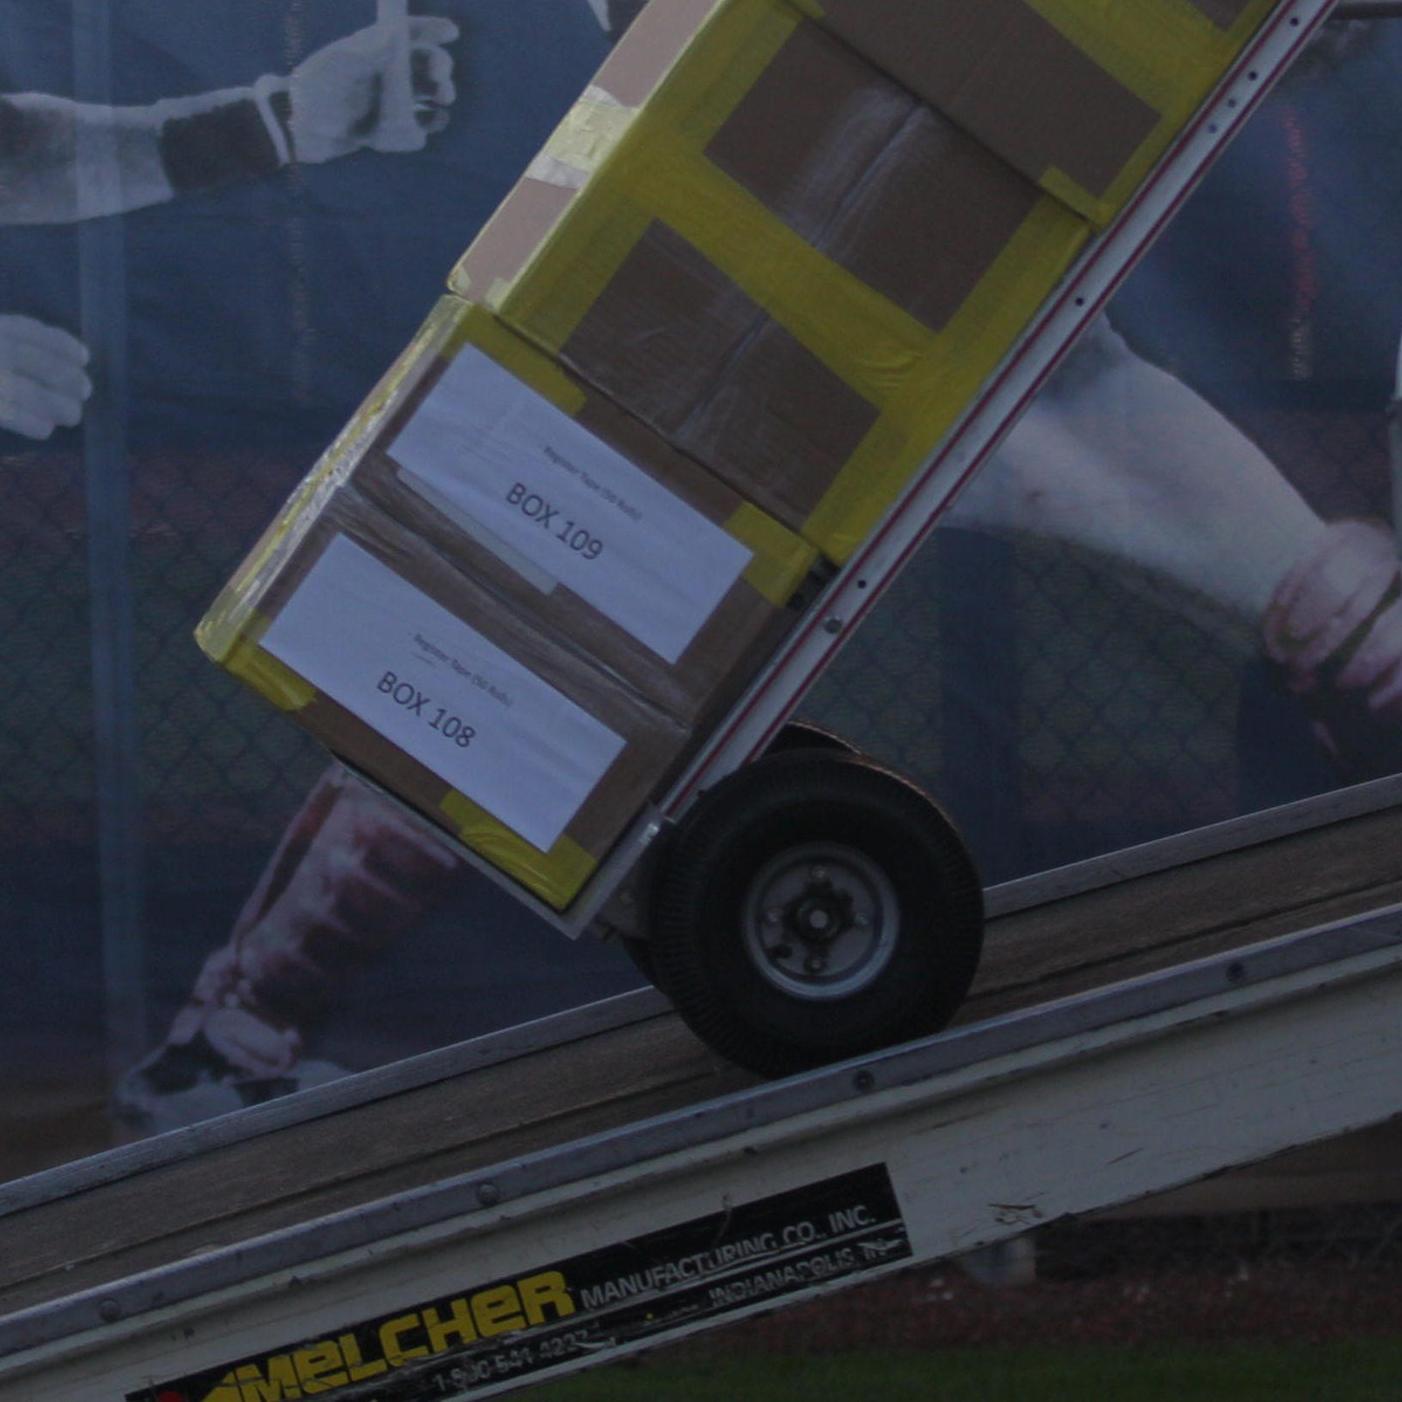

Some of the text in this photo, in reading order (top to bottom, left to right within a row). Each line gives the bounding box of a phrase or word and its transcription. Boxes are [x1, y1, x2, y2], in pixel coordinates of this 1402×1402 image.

[505, 482, 604, 561] BOX 109
[376, 670, 477, 749] BOX 108
[580, 1232, 778, 1310] MANUFACTURING
[829, 1203, 877, 1235] INC.
[708, 1246, 857, 1309] INDIANAPOLIS
